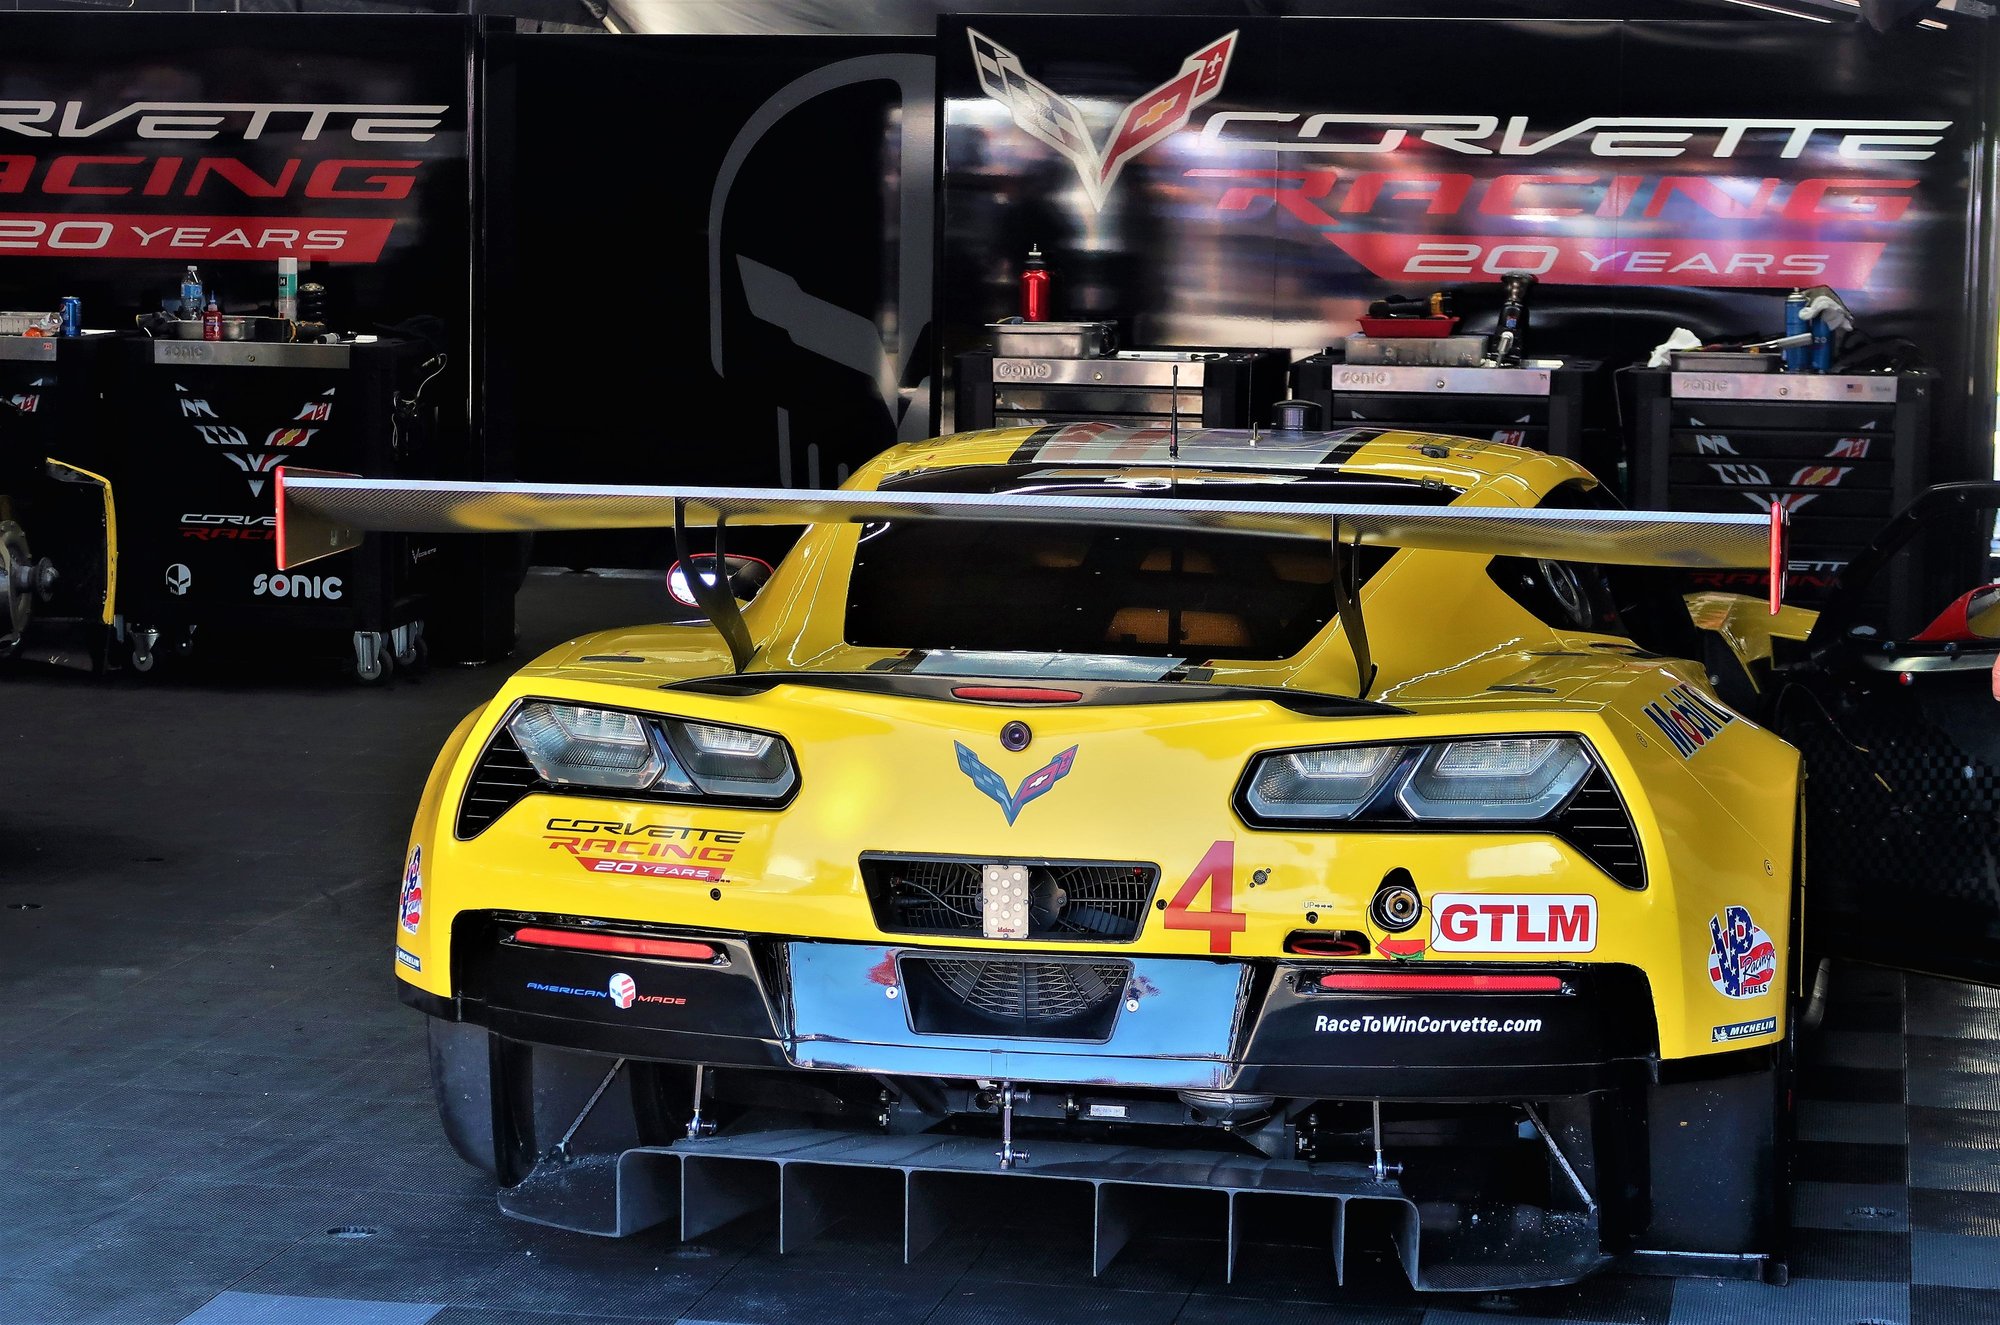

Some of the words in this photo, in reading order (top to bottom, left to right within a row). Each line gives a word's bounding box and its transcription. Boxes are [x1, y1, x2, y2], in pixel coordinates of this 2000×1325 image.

[1200, 111, 1954, 161] CORVETTE
[1183, 168, 1921, 226] RACING
[0, 220, 114, 250] 20
[130, 226, 348, 250] YEARS
[1403, 242, 1560, 275] 20
[1579, 250, 1831, 276] YEARS
[546, 818, 746, 844] CORVETTE
[542, 835, 736, 862] RACING
[594, 860, 638, 873] 20
[641, 864, 711, 878] YEARS
[1164, 841, 1247, 953] 4
[1440, 904, 1589, 942] GTLM
[1710, 906, 1754, 997] VP
[1742, 948, 1776, 982] Racing
[526, 981, 608, 998] AMERICAN
[637, 995, 687, 1005] MADE
[1743, 983, 1768, 995] FUELS
[1315, 1015, 1542, 1033] RaceToWinCorvette.com
[1729, 1019, 1775, 1036] MICHELIN
